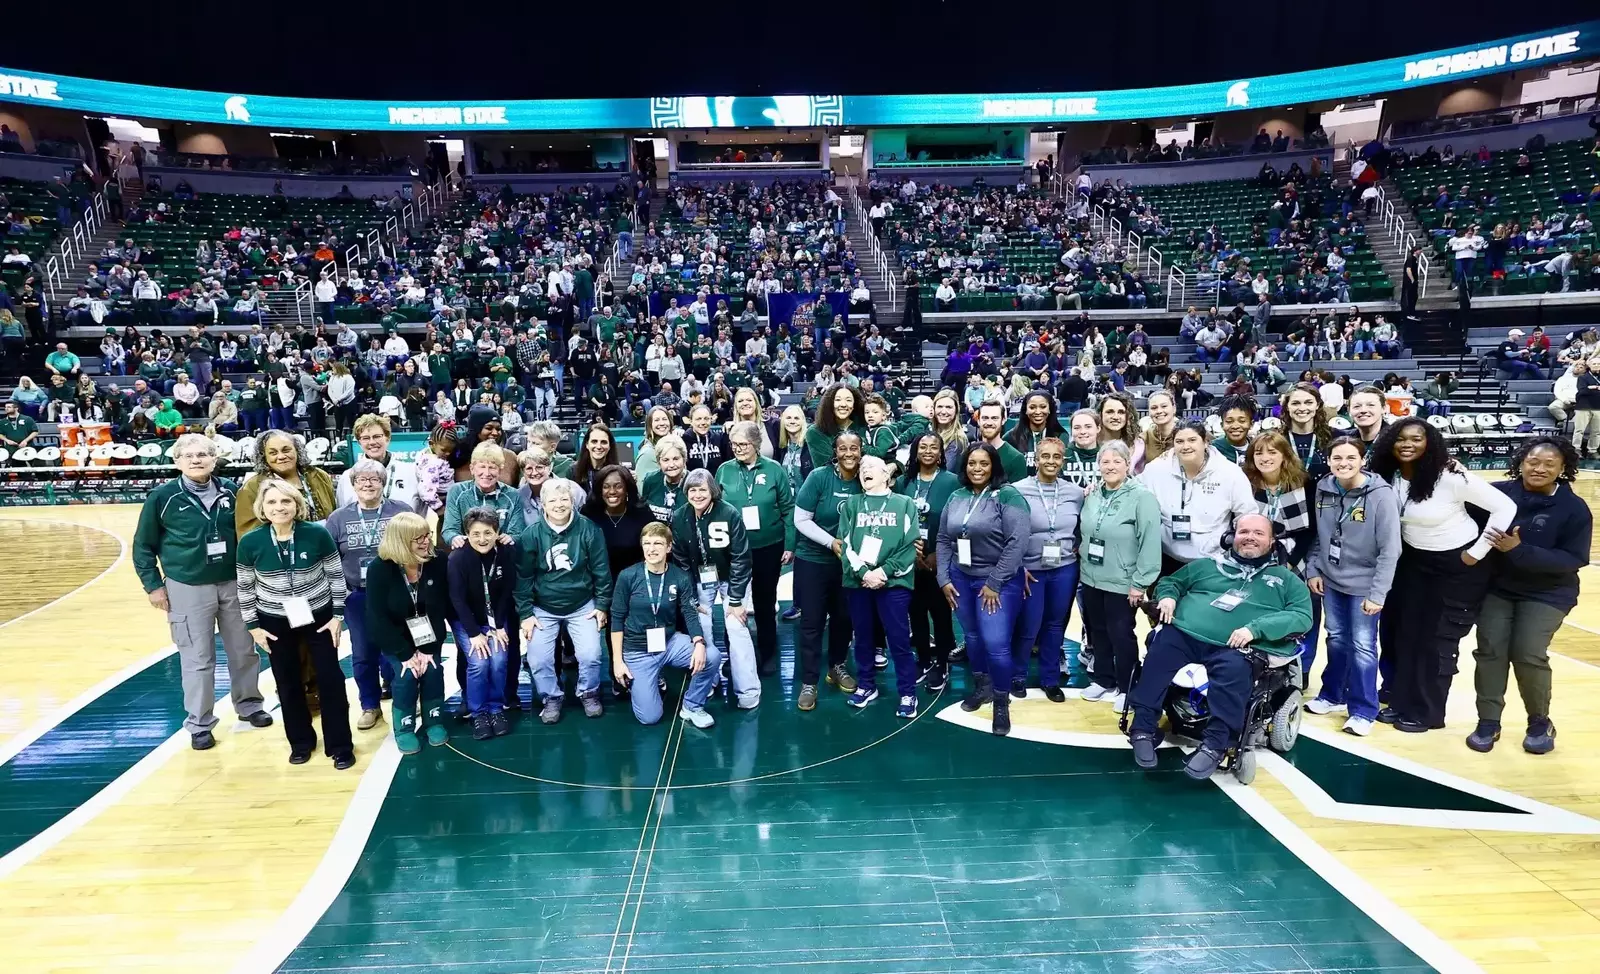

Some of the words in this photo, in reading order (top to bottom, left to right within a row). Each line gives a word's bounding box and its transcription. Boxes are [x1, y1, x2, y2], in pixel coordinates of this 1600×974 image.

[1403, 45, 1508, 82] MICHIGAN
[1510, 30, 1580, 63] STATE
[388, 107, 462, 125] MICHIGAN
[463, 106, 509, 124] STATE
[983, 99, 1053, 117] MICHIGAN
[1055, 97, 1099, 116] STATE
[708, 521, 730, 549] S
